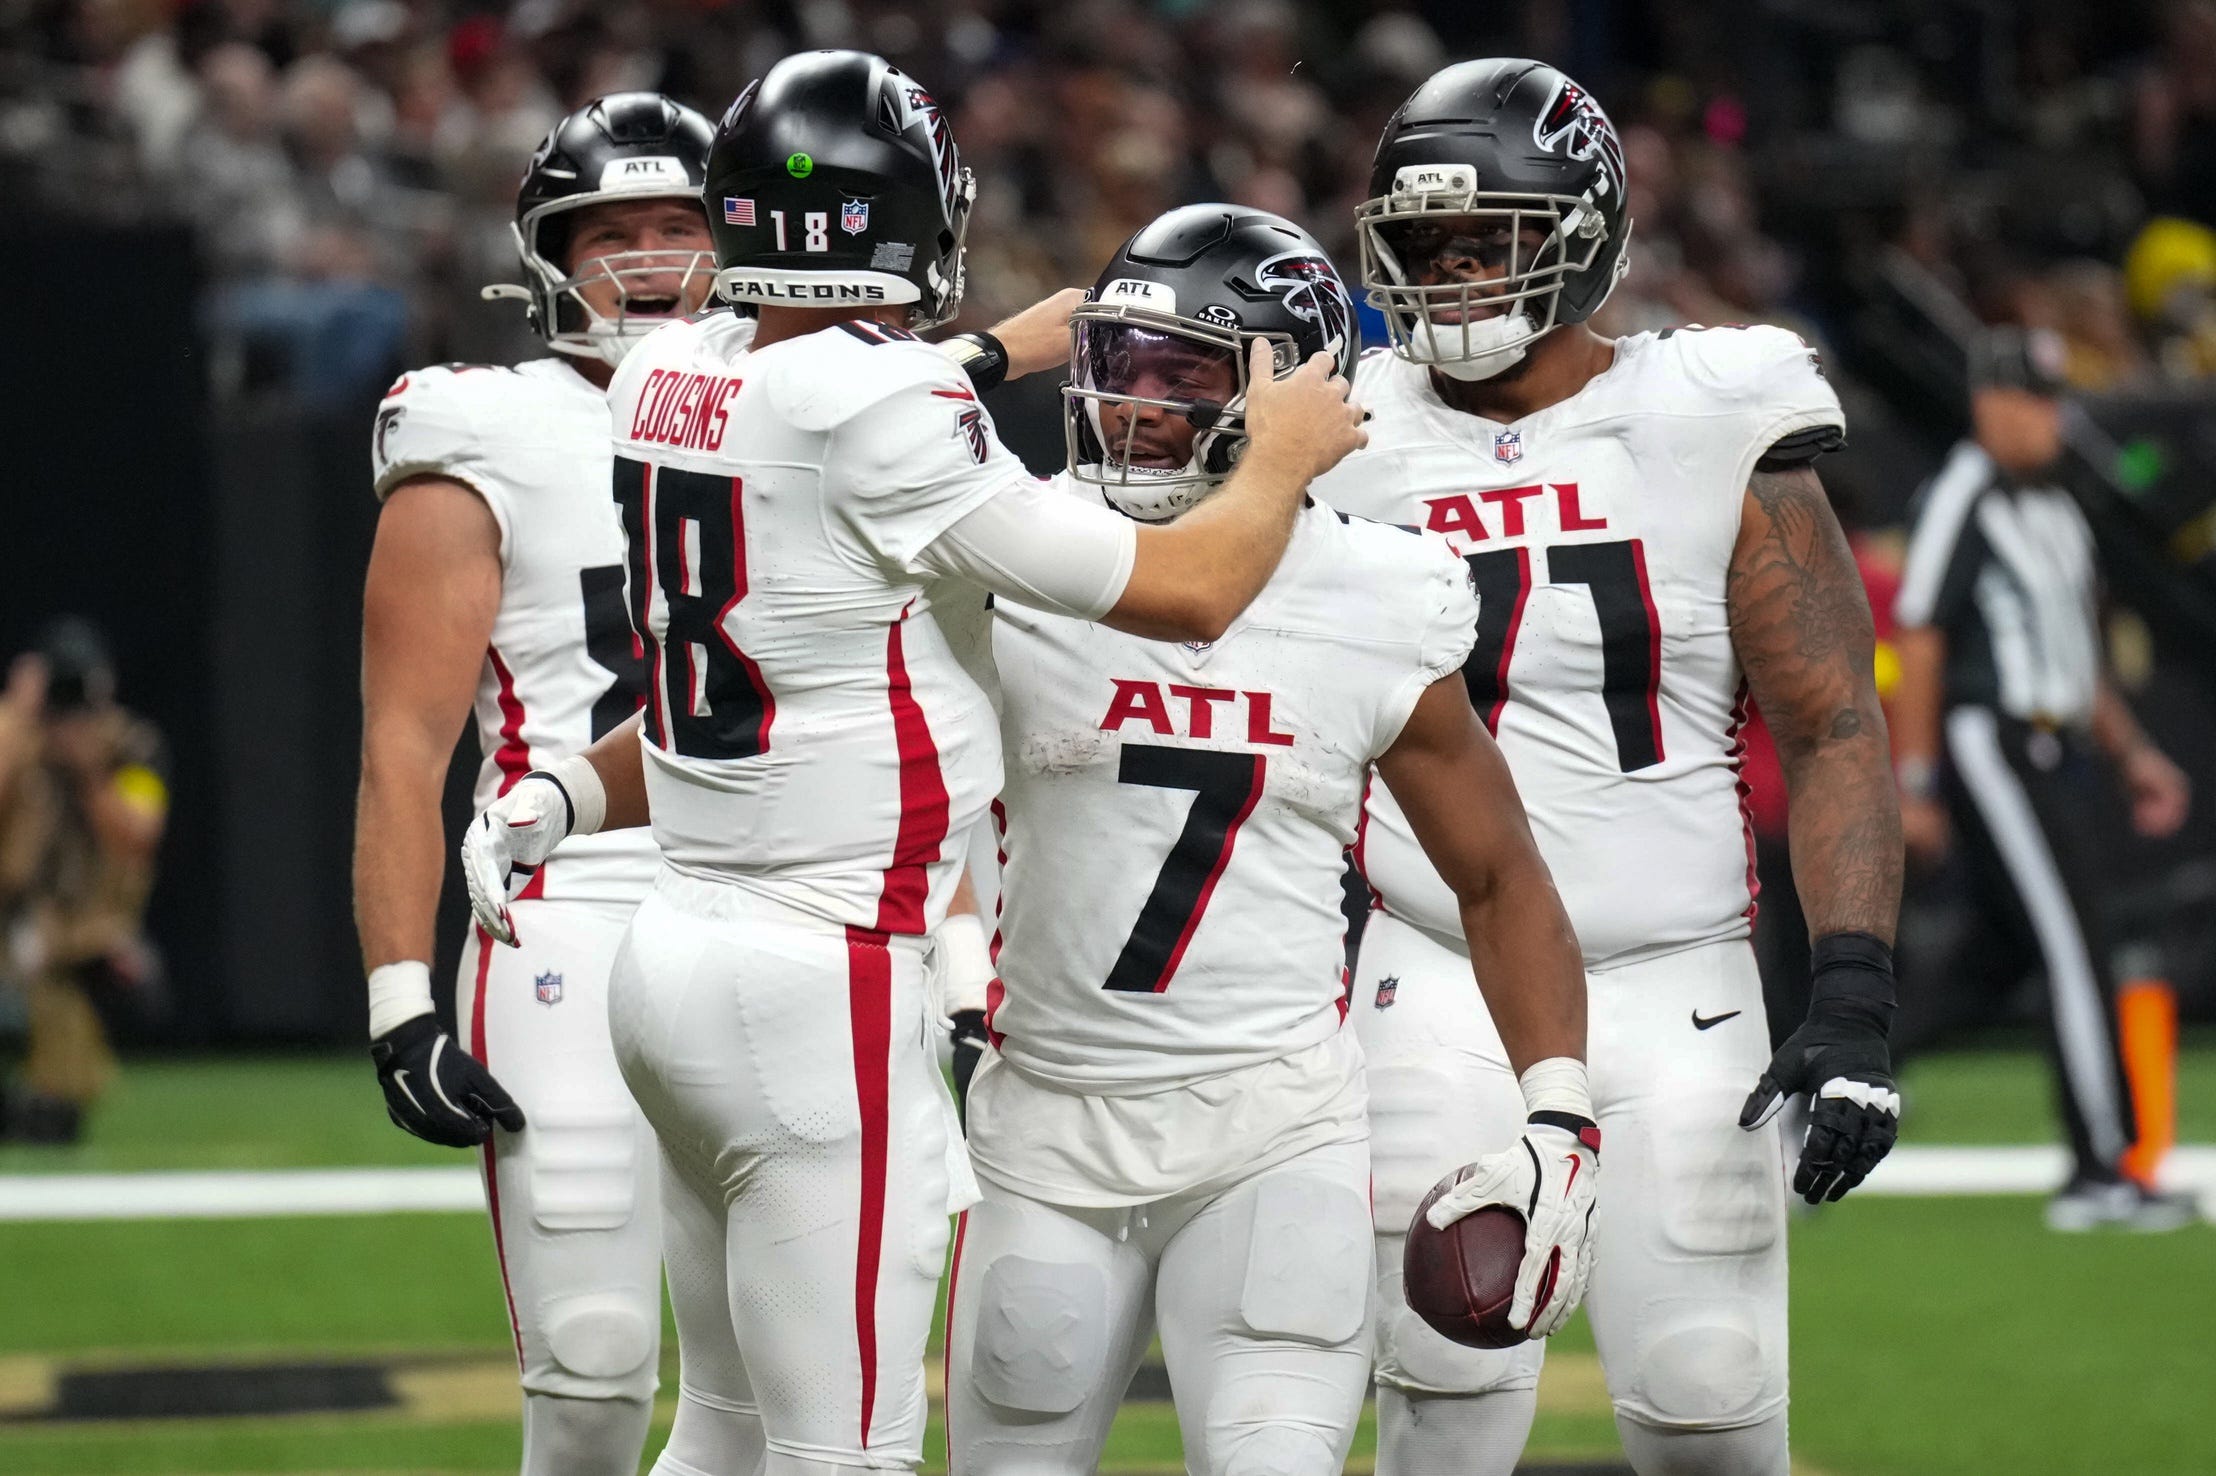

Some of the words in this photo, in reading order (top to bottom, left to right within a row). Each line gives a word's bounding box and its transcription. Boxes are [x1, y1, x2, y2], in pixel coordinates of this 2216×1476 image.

[624, 161, 665, 173] ATL
[1418, 173, 1443, 183] ATL
[845, 215, 865, 229] NFL
[731, 282, 885, 300] FALCONS
[1116, 282, 1152, 297] ATL
[1198, 312, 1239, 330] OAKLEY
[630, 368, 742, 451] COUSINS
[1422, 483, 1607, 542] ATL
[613, 455, 776, 760] 18
[1100, 678, 1295, 746] ATL
[1101, 743, 1266, 993] 7
